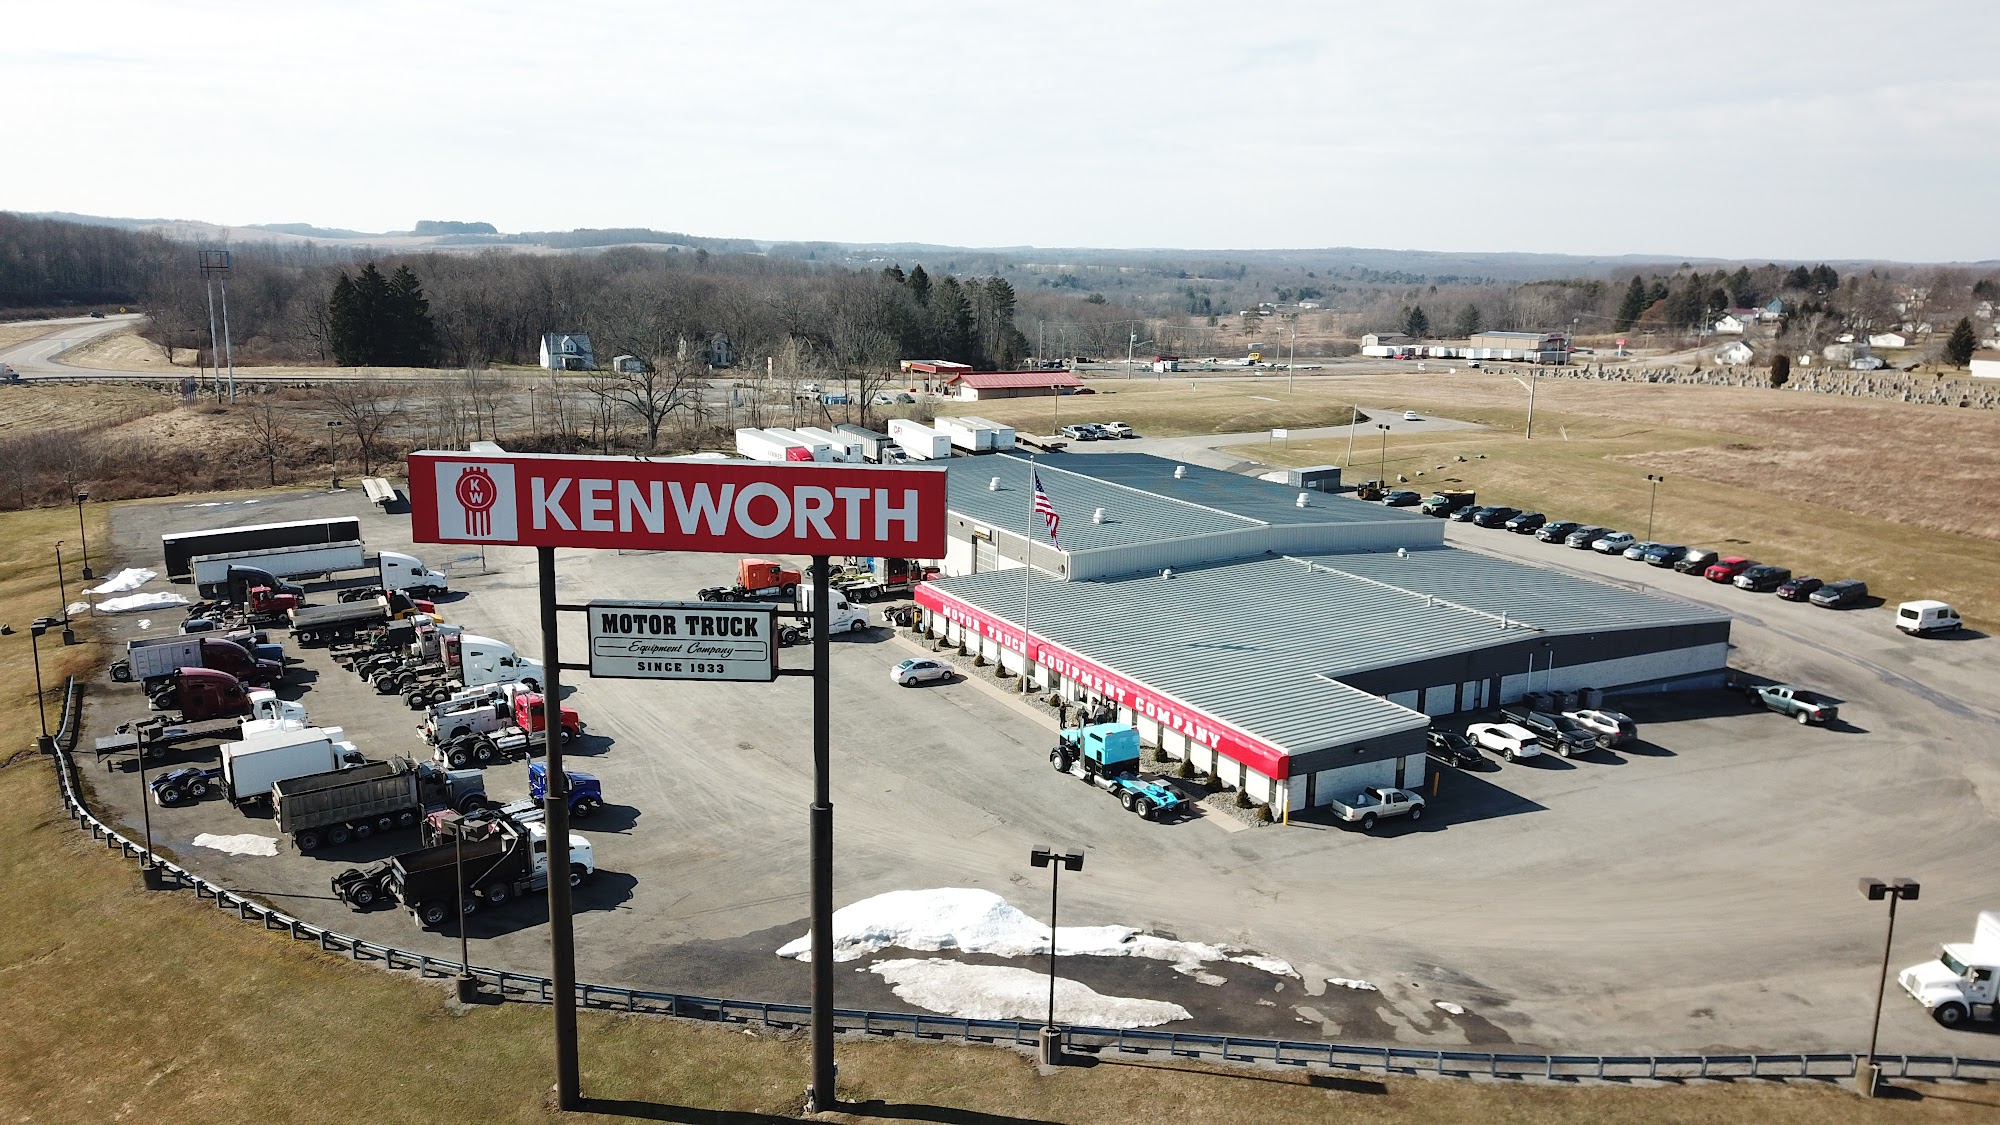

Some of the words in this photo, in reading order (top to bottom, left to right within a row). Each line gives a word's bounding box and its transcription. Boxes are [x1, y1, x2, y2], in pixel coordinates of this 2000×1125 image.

[531, 477, 919, 542] KENWORTH
[602, 613, 677, 635] MOTOR
[685, 615, 759, 637] TRUCK
[628, 640, 683, 655] Equipment
[686, 642, 735, 658] Company
[637, 661, 682, 673] SINCE
[690, 663, 725, 674] 1933
[942, 604, 981, 632] MOTOR
[987, 625, 1026, 654] TRUCK
[1037, 650, 1126, 702] EQUIPMENT
[1135, 697, 1221, 749] COMPANY
